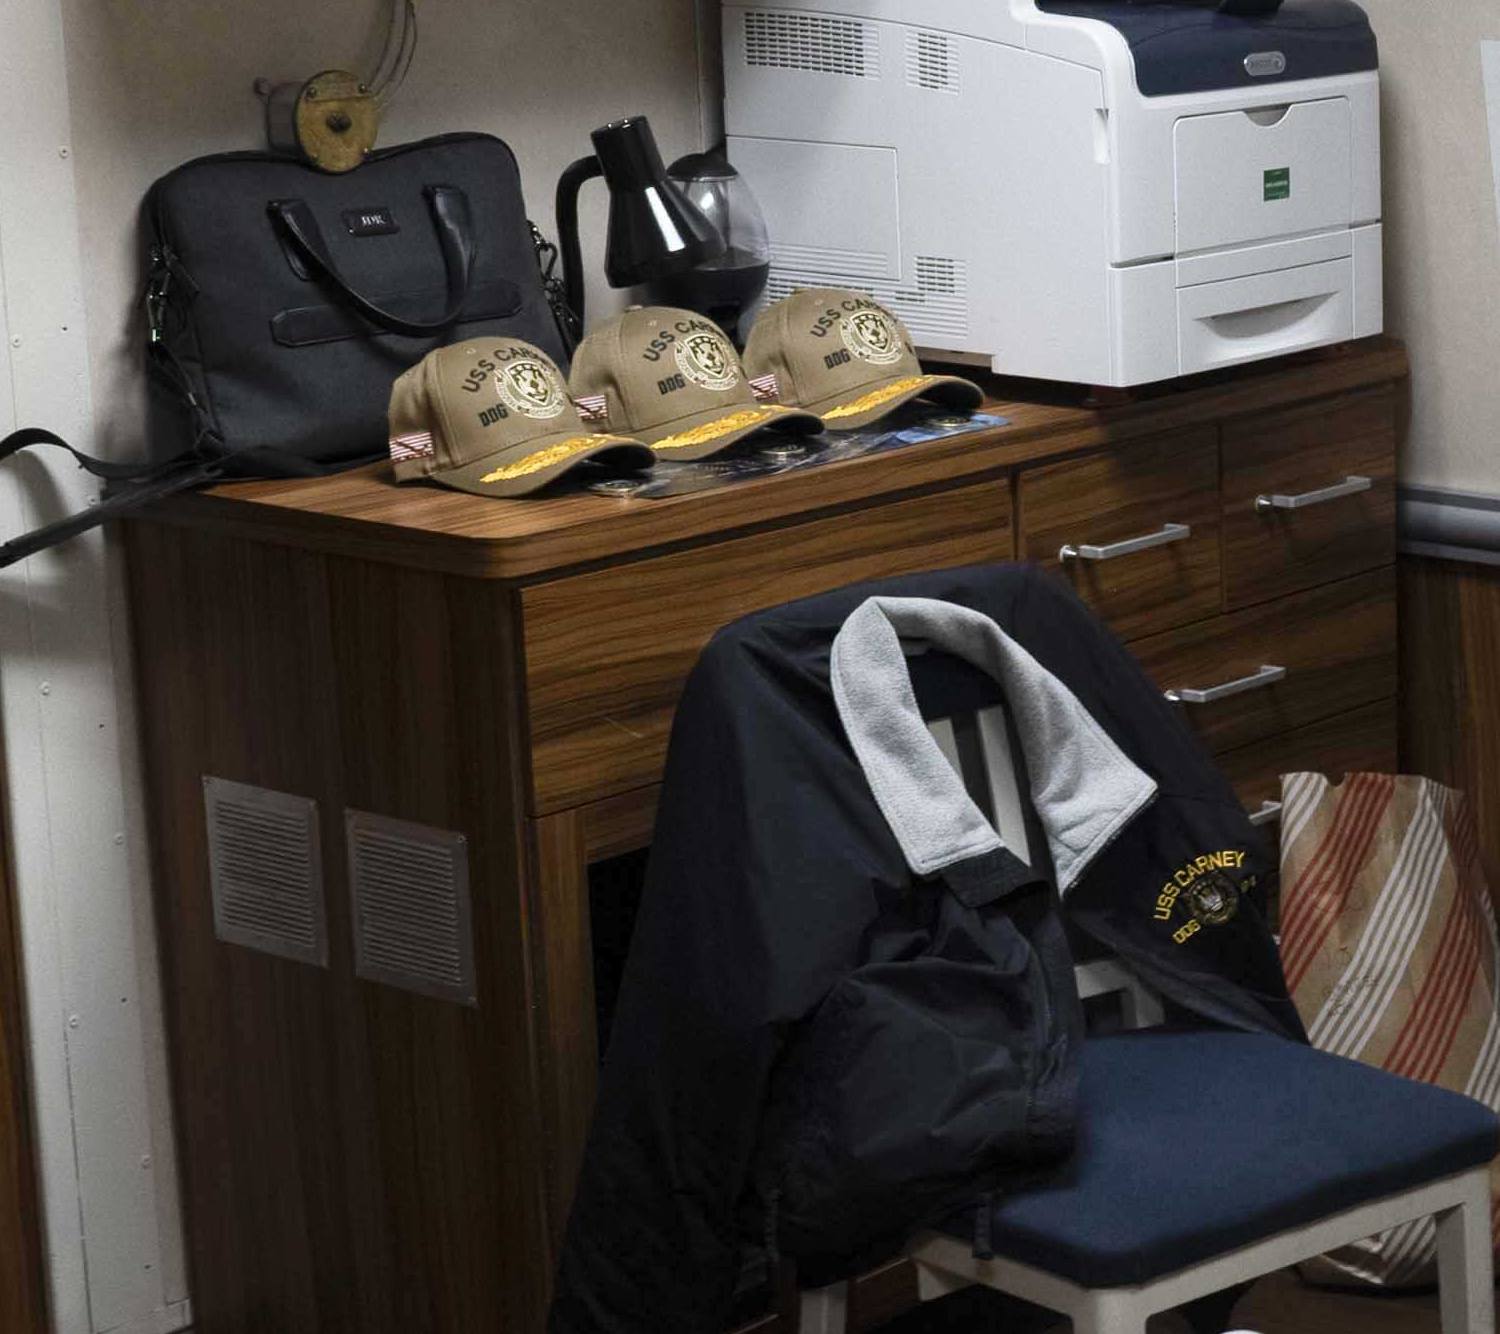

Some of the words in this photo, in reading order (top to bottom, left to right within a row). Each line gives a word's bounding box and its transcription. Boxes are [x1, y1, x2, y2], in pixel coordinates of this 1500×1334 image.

[810, 308, 842, 339] USS
[643, 329, 676, 362] USS
[461, 359, 496, 394] USS
[657, 373, 687, 396] DDG
[477, 402, 510, 428] DDG
[1153, 882, 1181, 921] USS
[1173, 850, 1246, 887] CARNEY
